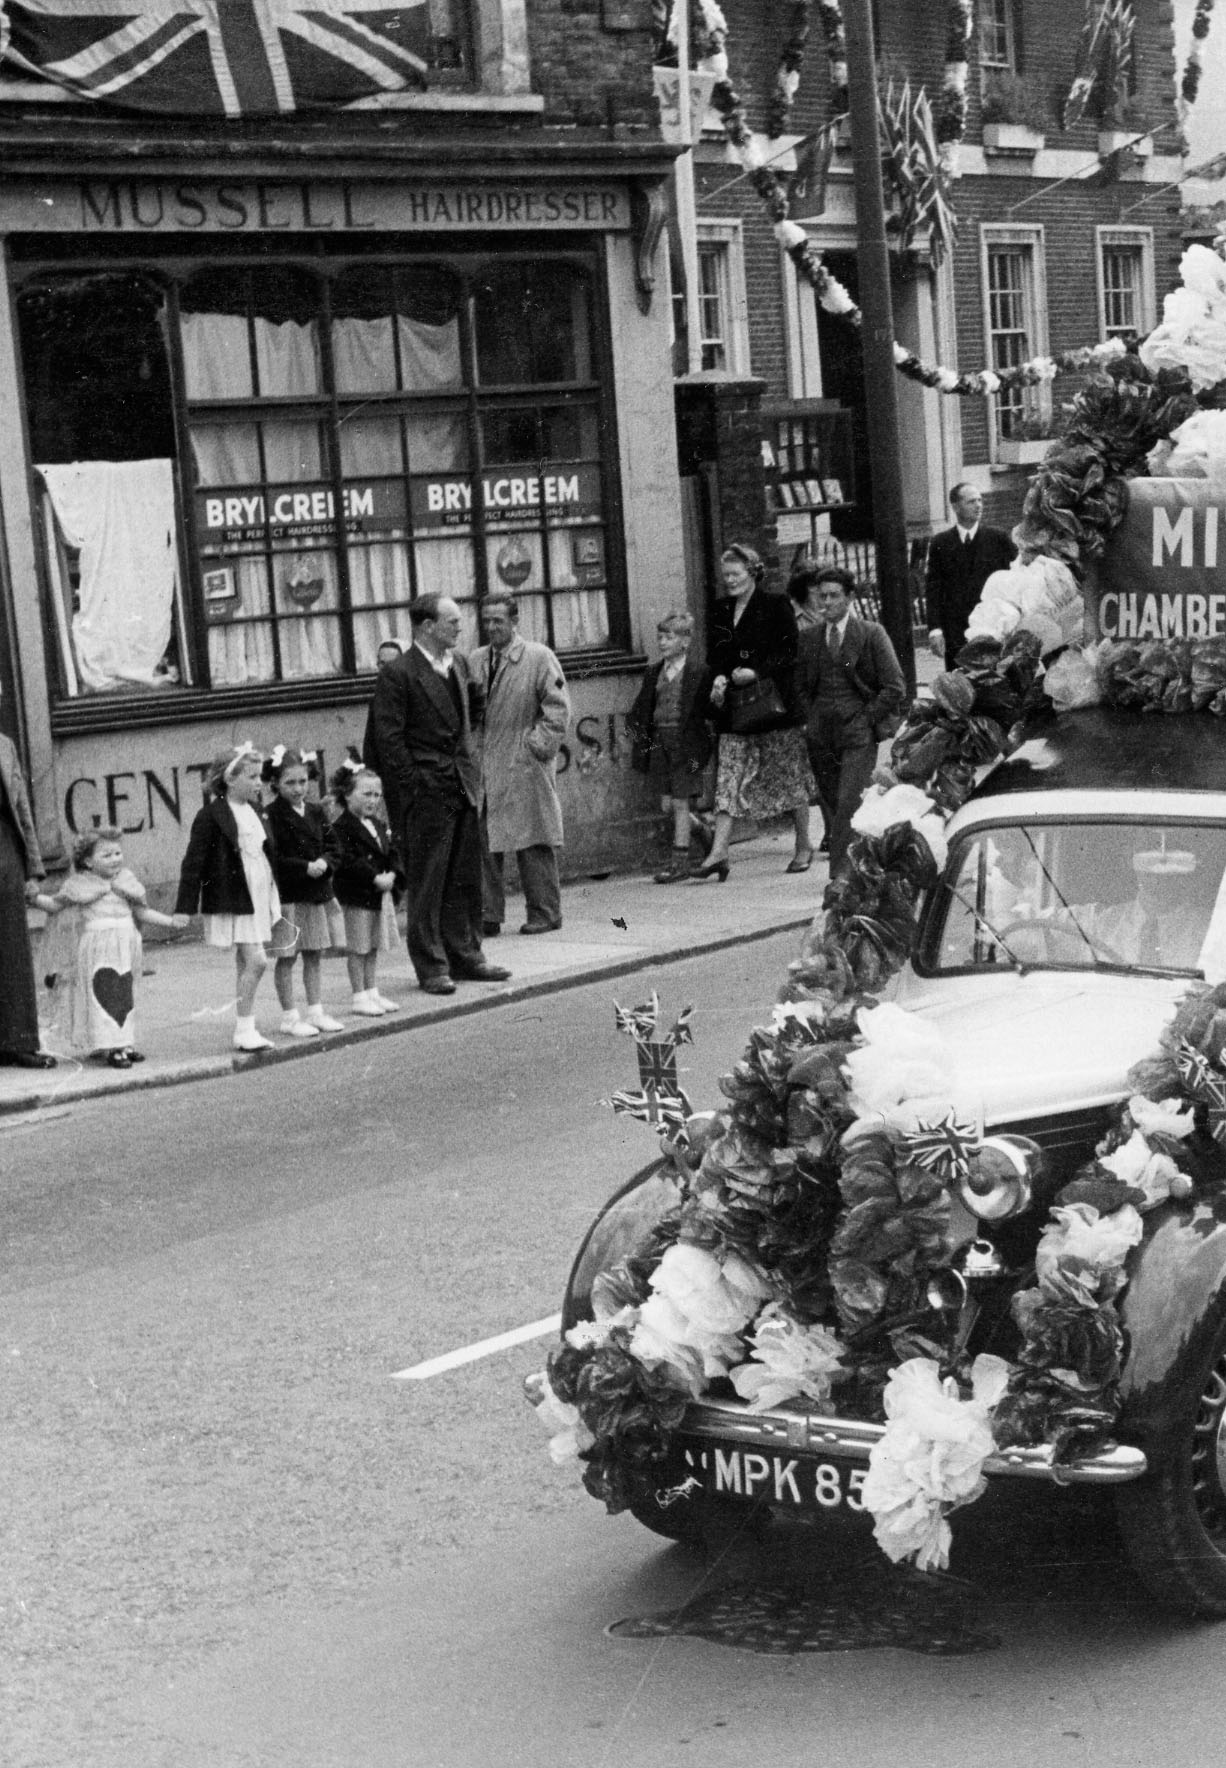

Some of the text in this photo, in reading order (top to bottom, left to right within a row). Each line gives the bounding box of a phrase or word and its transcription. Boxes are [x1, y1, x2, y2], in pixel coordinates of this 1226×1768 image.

[79, 180, 618, 229] MUSSELL HAIRDRESSER
[206, 488, 374, 527] BRYLCREEM
[428, 475, 580, 511] BRYLCREEM
[714, 1448, 867, 1511] MPK 85
